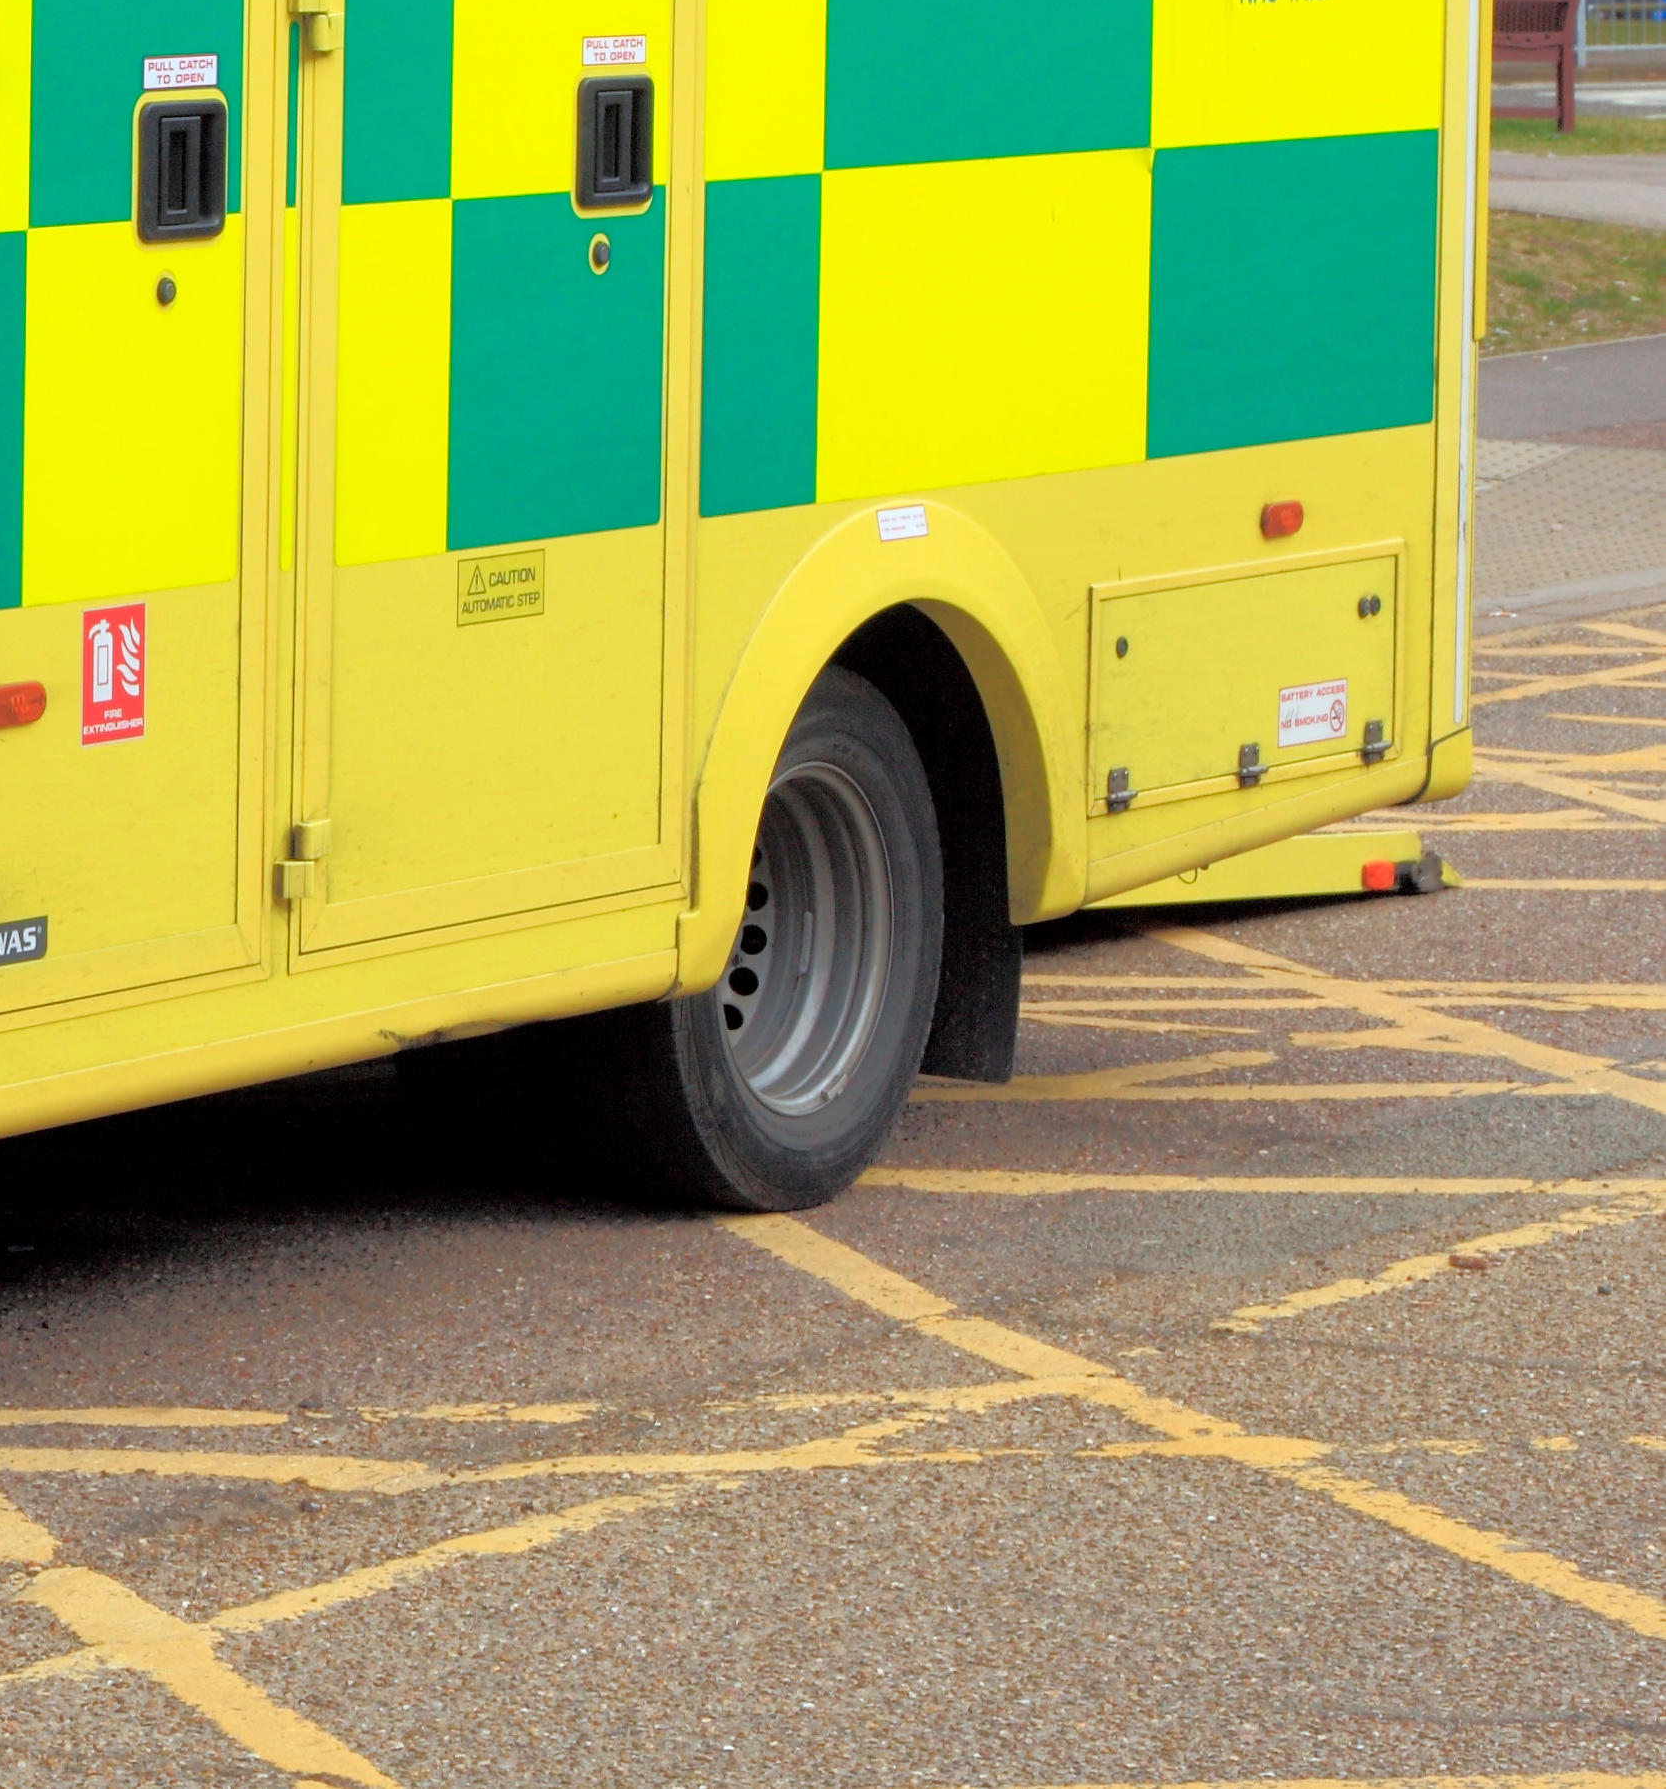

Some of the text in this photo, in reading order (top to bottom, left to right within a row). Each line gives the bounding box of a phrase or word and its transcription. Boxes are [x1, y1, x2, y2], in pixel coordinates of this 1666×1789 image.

[586, 38, 643, 49] PULL CATCH
[594, 51, 636, 61] TO OPEN
[149, 59, 213, 72] PULL CATCH
[157, 73, 205, 84] TO OPEN
[489, 566, 536, 587] CAUTION
[461, 591, 541, 615] AUTOMATIC STEP
[1281, 684, 1345, 702] BATTERY ACCESS
[104, 708, 122, 719] FIRE
[83, 717, 143, 736] EXTINGUISHER
[1281, 713, 1329, 729] NO SMOKING
